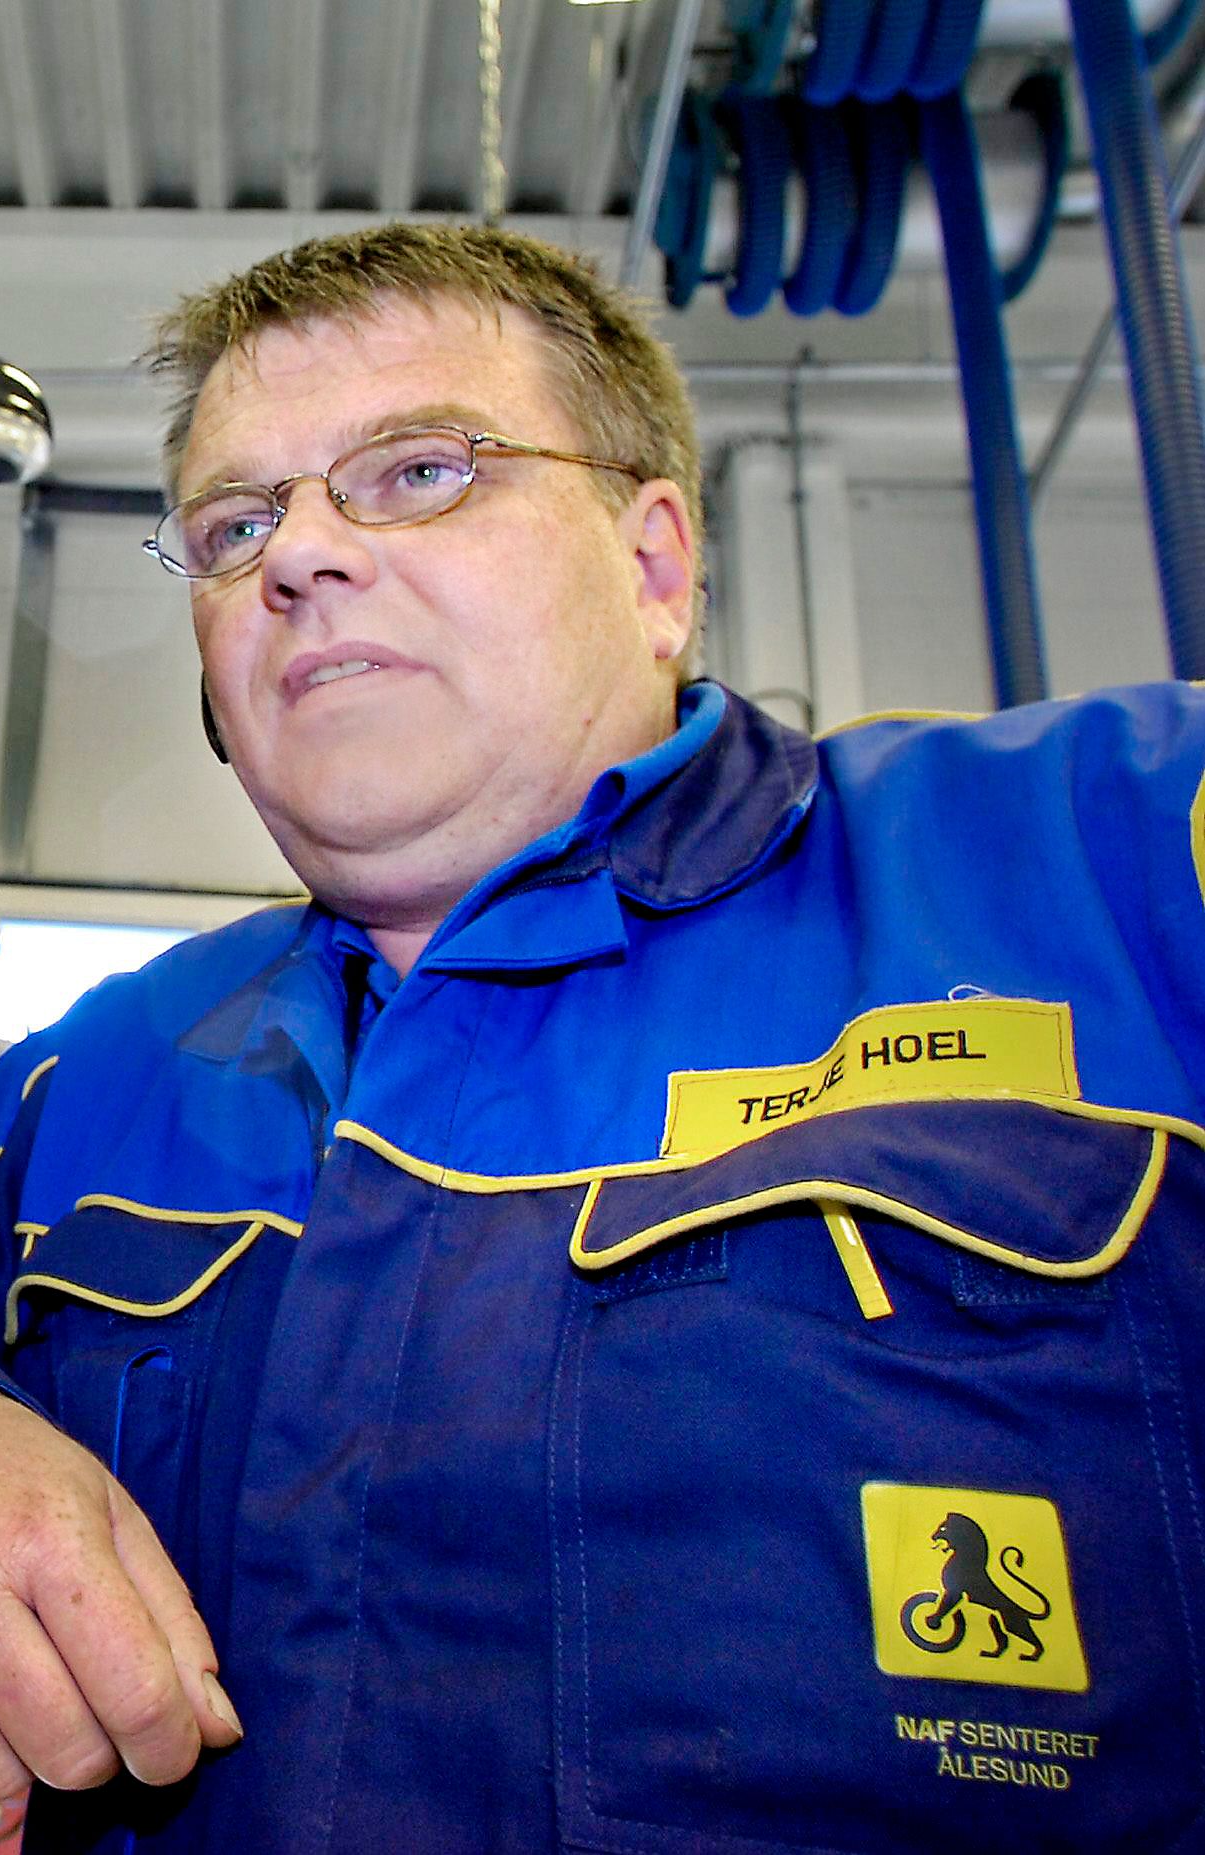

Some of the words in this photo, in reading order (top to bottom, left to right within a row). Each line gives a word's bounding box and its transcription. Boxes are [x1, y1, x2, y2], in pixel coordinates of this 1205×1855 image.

[737, 1054, 846, 1125] TERJE
[860, 1029, 987, 1070] HOEL
[896, 1714, 957, 1743] NAF
[958, 1720, 1100, 1758] SENTERET
[938, 1746, 1072, 1790] ÅLESUND
